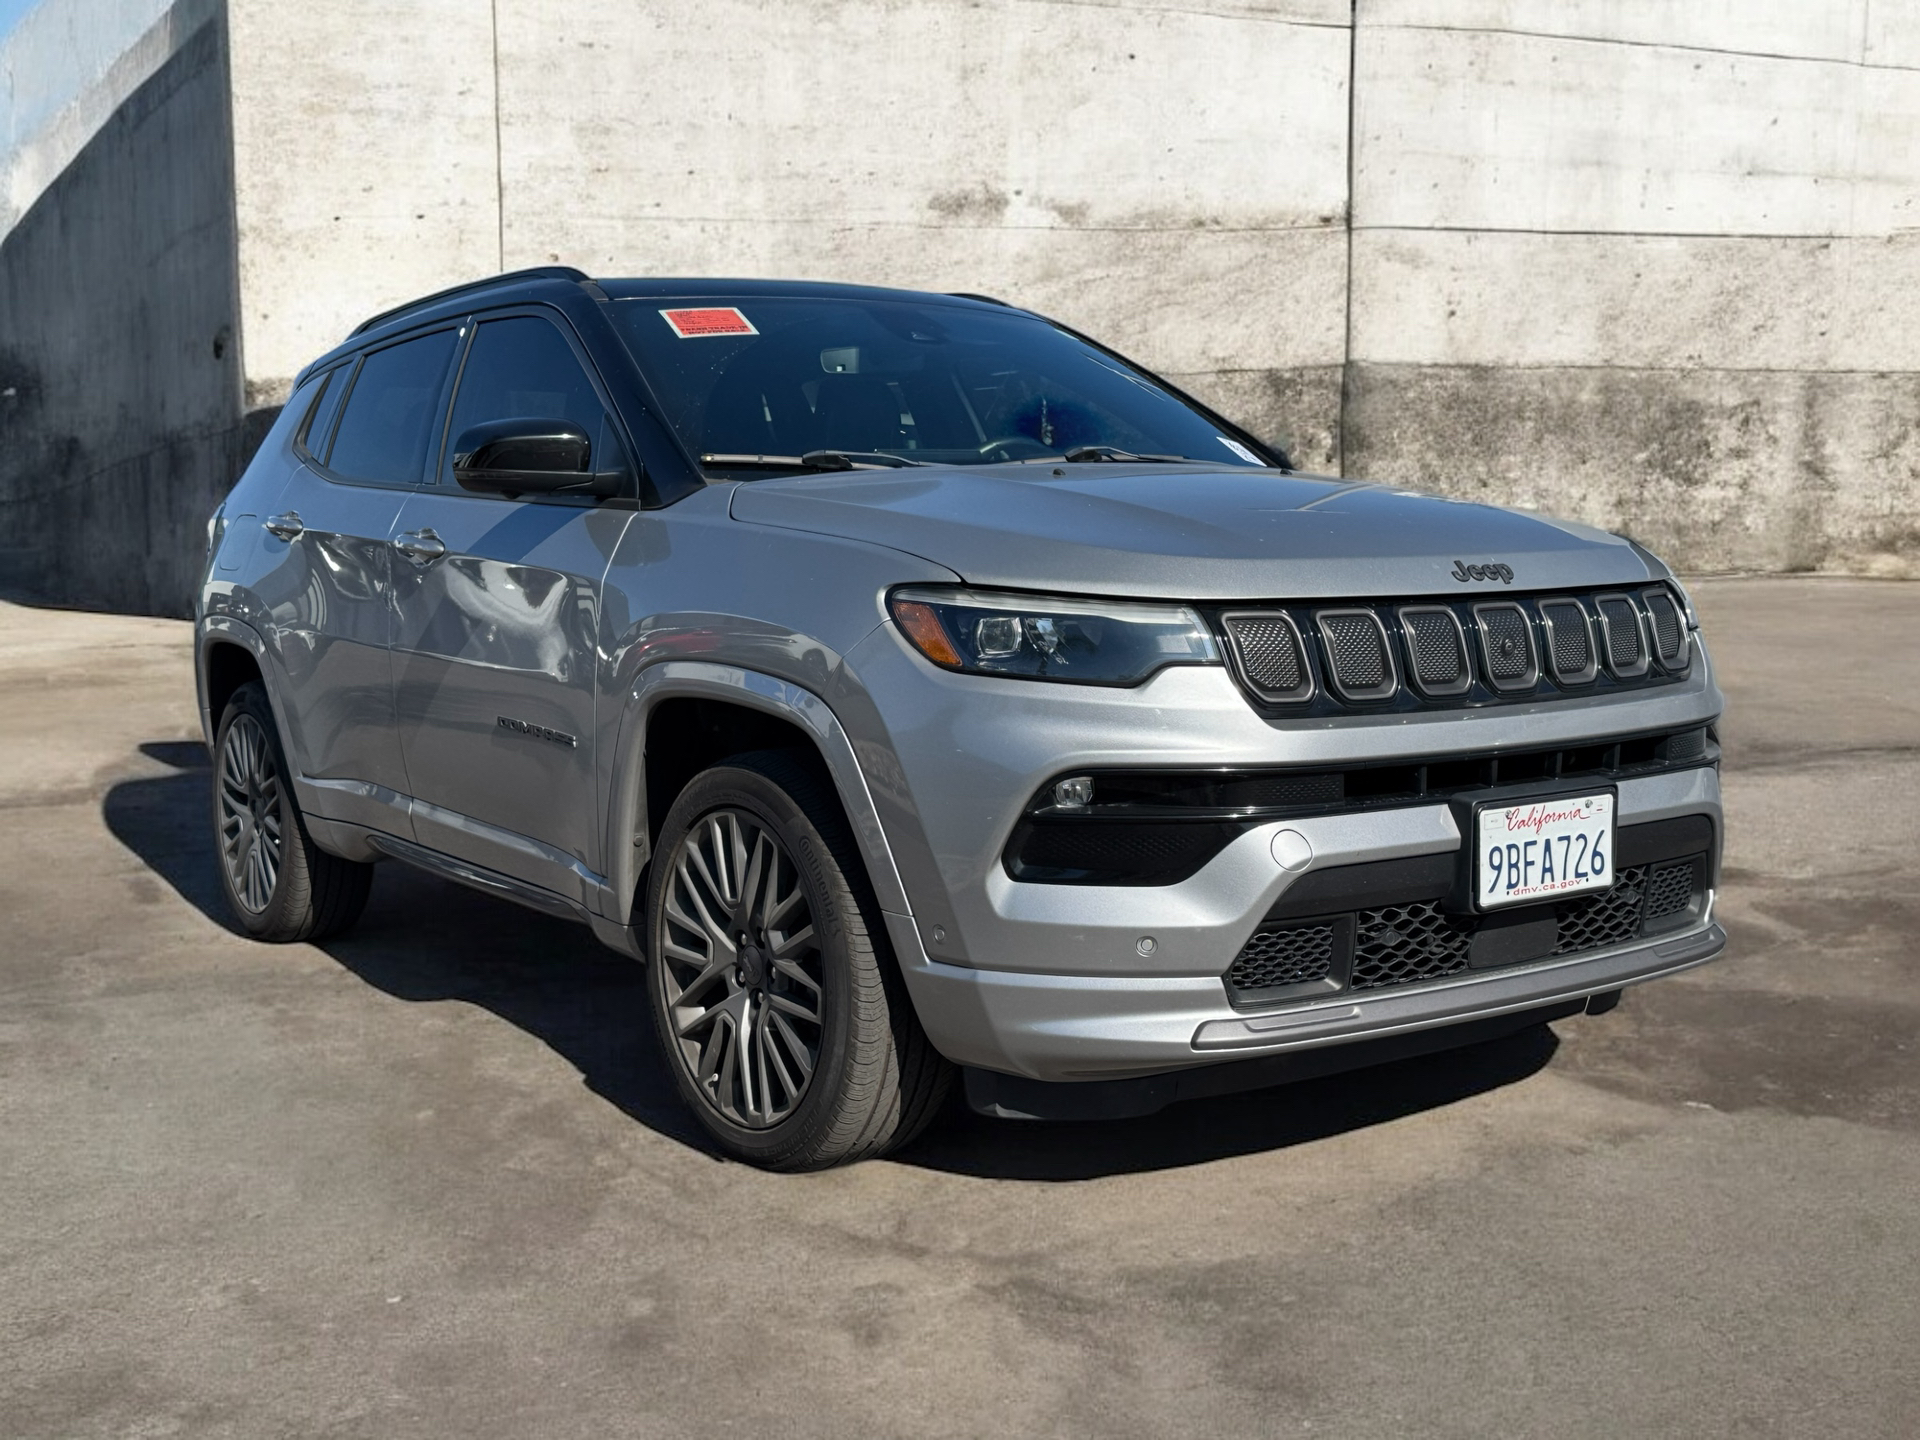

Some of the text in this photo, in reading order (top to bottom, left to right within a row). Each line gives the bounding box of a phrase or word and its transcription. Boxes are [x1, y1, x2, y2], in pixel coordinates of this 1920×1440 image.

[1451, 560, 1514, 585] Jeep
[1507, 805, 1590, 834] California
[1488, 829, 1605, 893] 9BFA726
[799, 836, 839, 924] Continental
[1513, 878, 1582, 896] dmv.ca.gov
